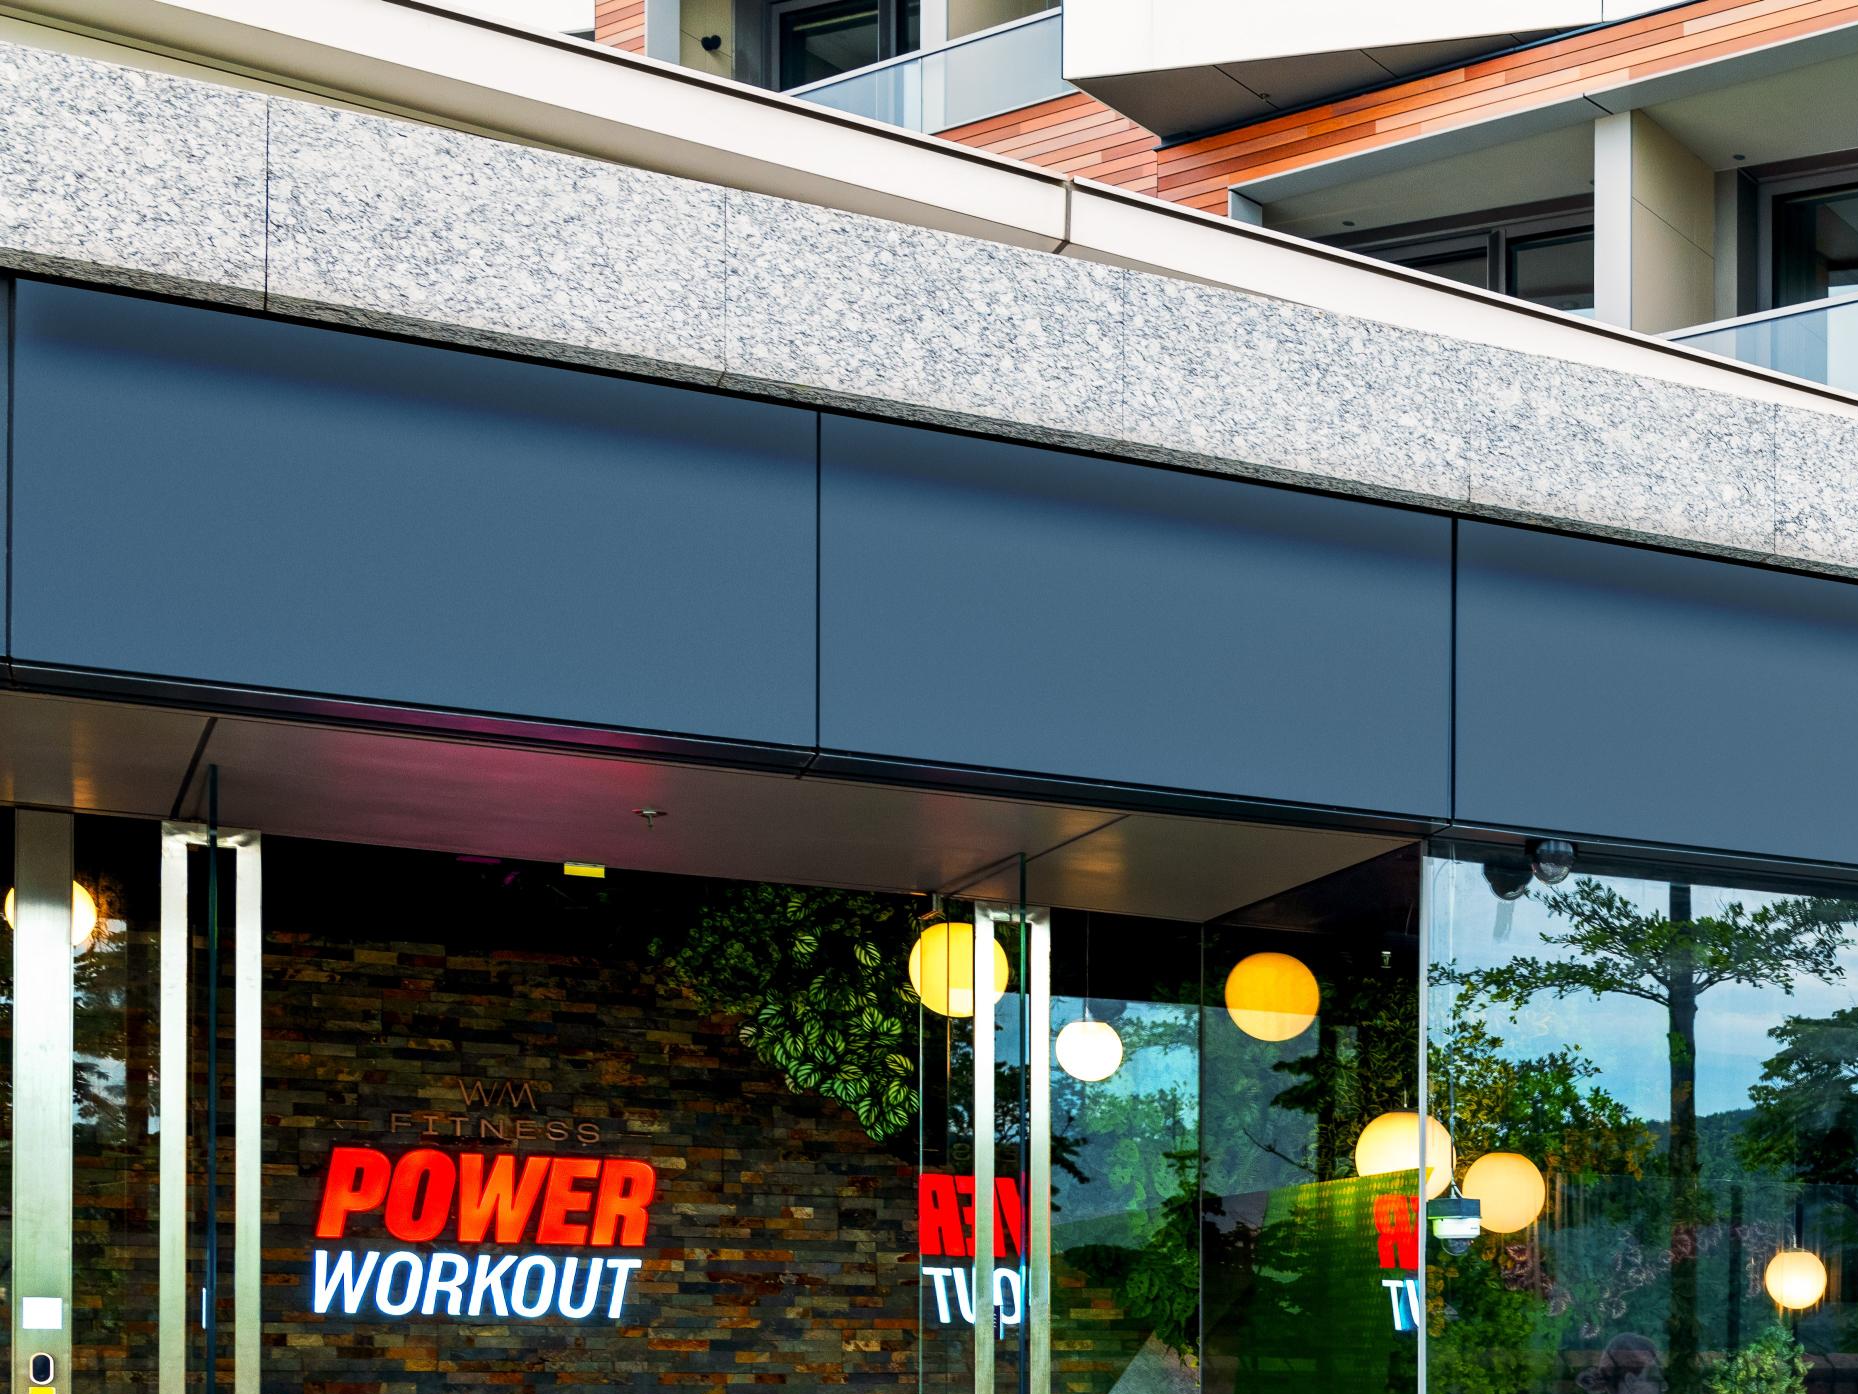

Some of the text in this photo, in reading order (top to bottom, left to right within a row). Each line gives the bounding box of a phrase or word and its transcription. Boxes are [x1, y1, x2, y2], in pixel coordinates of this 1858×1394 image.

[390, 1112, 600, 1143] FITNESS
[314, 1146, 657, 1247] POWER
[313, 1249, 642, 1320] WORKOUT
